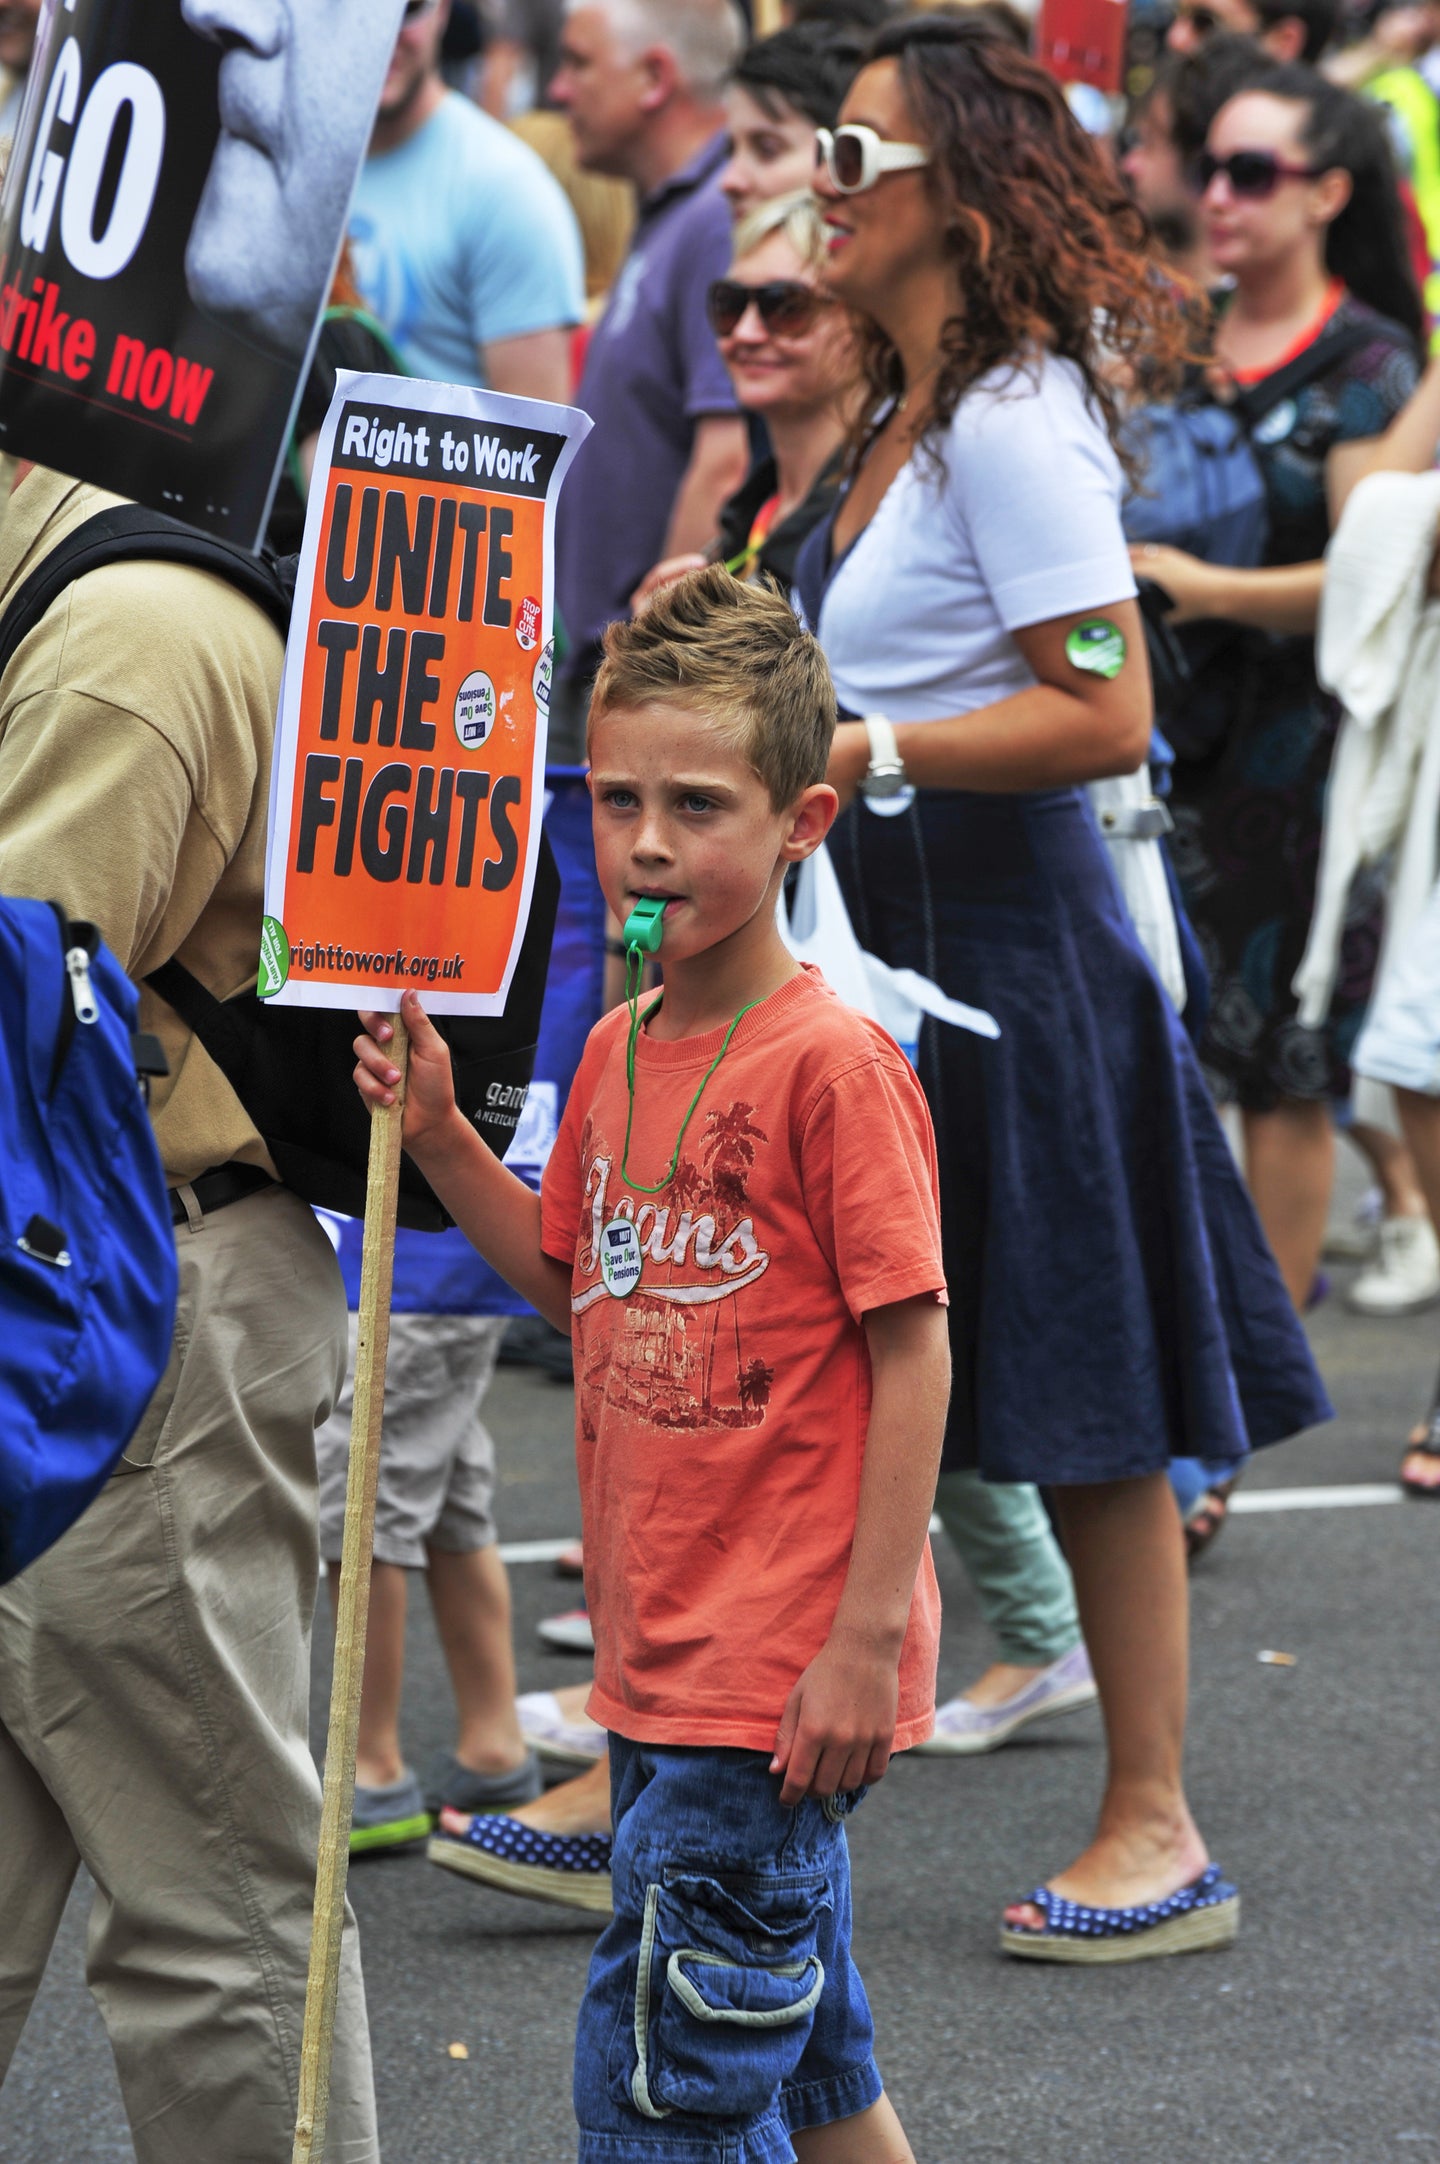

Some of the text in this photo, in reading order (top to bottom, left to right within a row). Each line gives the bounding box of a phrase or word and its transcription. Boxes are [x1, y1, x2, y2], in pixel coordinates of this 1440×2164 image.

[20, 35, 166, 280] GO
[105, 333, 215, 426] now
[341, 415, 542, 483] Right to Work
[325, 483, 514, 629] UNITE
[522, 598, 541, 616] STOP
[522, 609, 536, 627] THE
[518, 620, 536, 639] CUTS
[317, 619, 446, 752] THE
[458, 687, 491, 702] Pensions
[460, 702, 493, 720] Save Our
[296, 752, 522, 892] FIGHTS
[267, 919, 283, 956] FOR ALL
[290, 939, 466, 982] righttowork.org.uk
[604, 1247, 636, 1267] Save Our
[608, 1265, 640, 1282] Pensions
